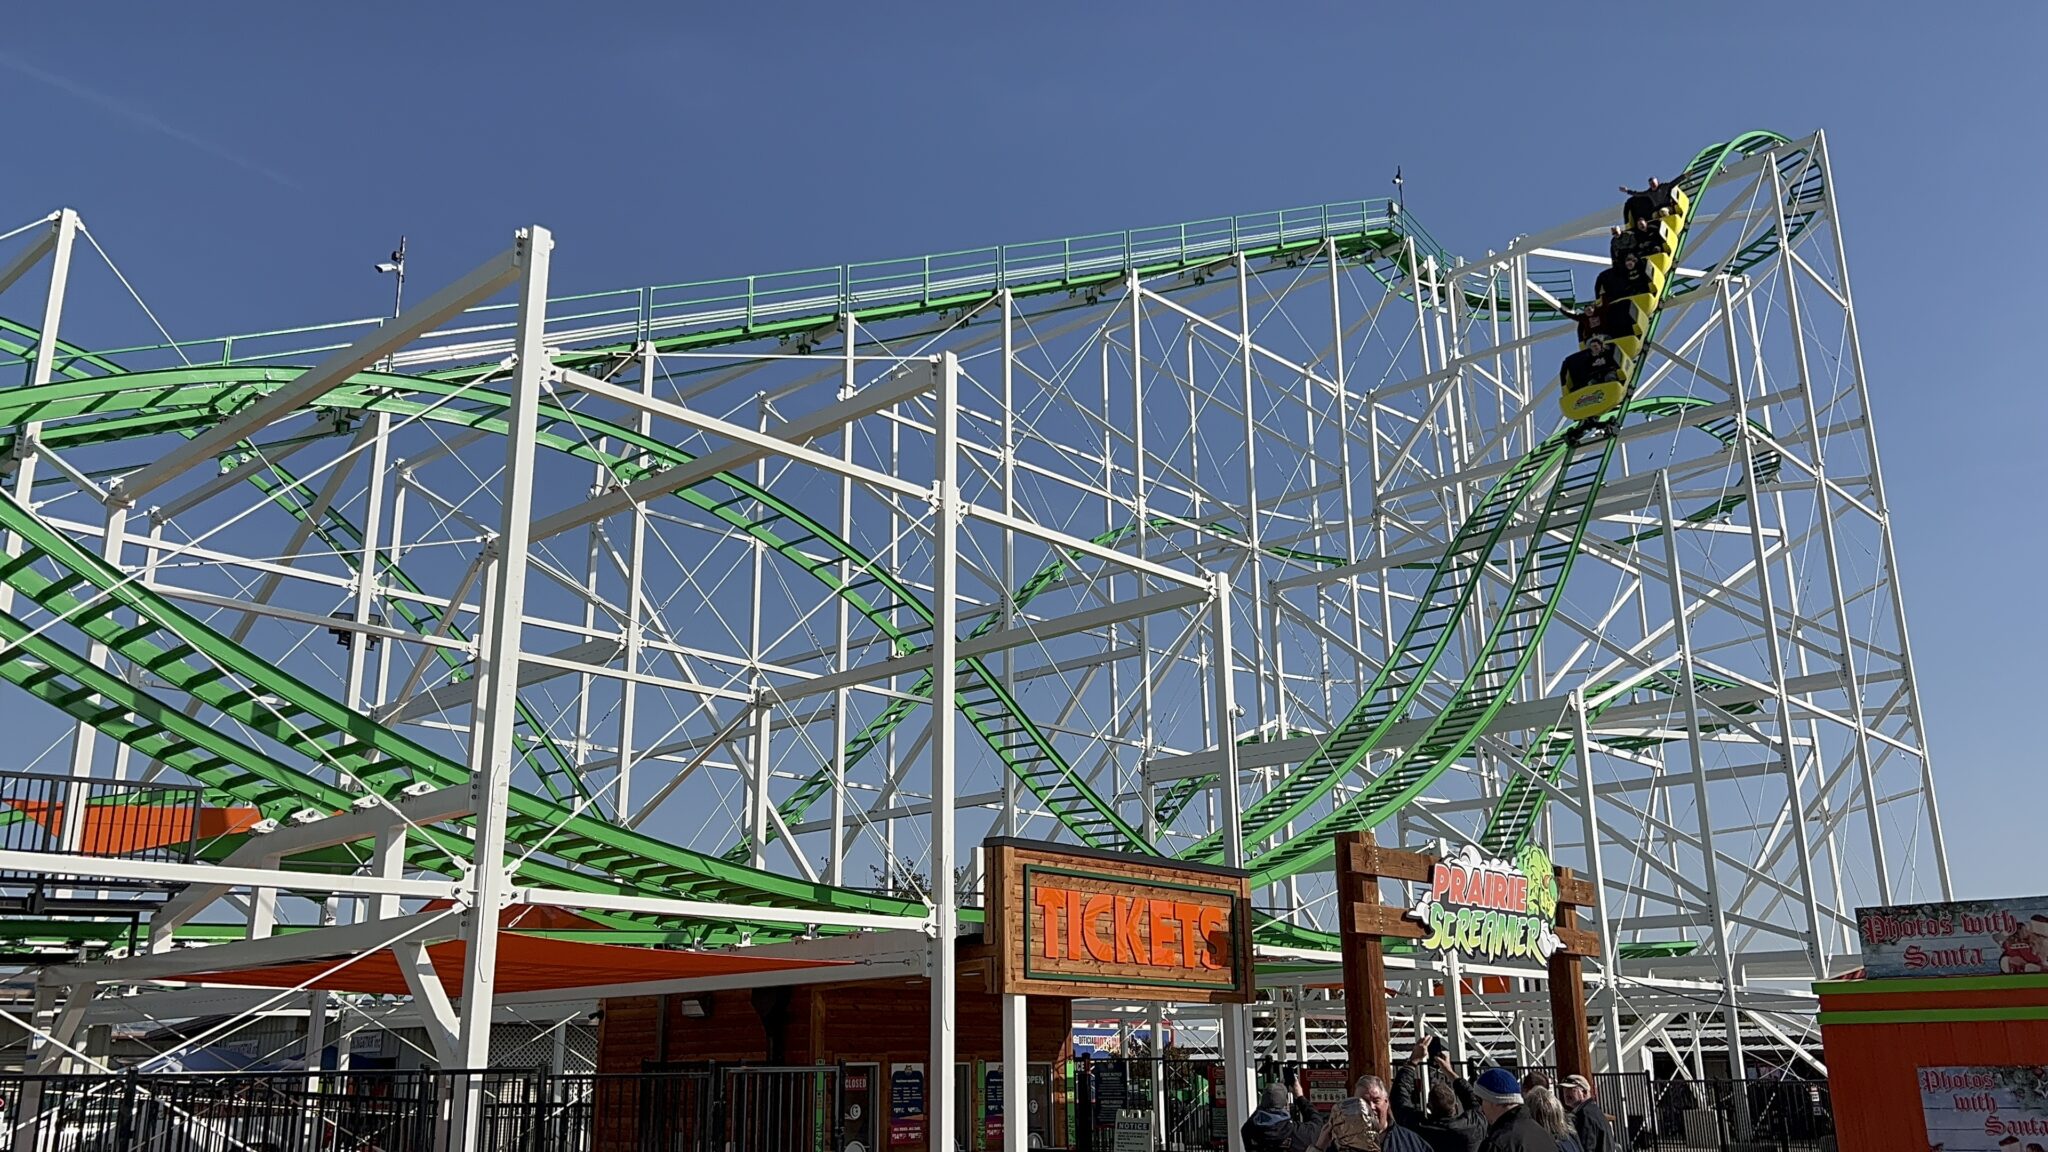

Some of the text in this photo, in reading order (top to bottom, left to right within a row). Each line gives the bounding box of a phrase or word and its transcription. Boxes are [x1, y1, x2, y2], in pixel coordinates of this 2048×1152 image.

[1432, 865, 1528, 913] PRAIRIE
[1035, 887, 1230, 970] TICKETS
[1423, 902, 1548, 966] SCREAMER
[1862, 910, 2018, 945] Photos with
[1903, 944, 1985, 969] Santa
[844, 1078, 867, 1089] CLOSED
[1923, 1069, 1996, 1093] Photos
[1953, 1093, 1999, 1114] with
[1119, 1122, 1148, 1131] NOTICE
[1985, 1115, 2048, 1137] Santa
